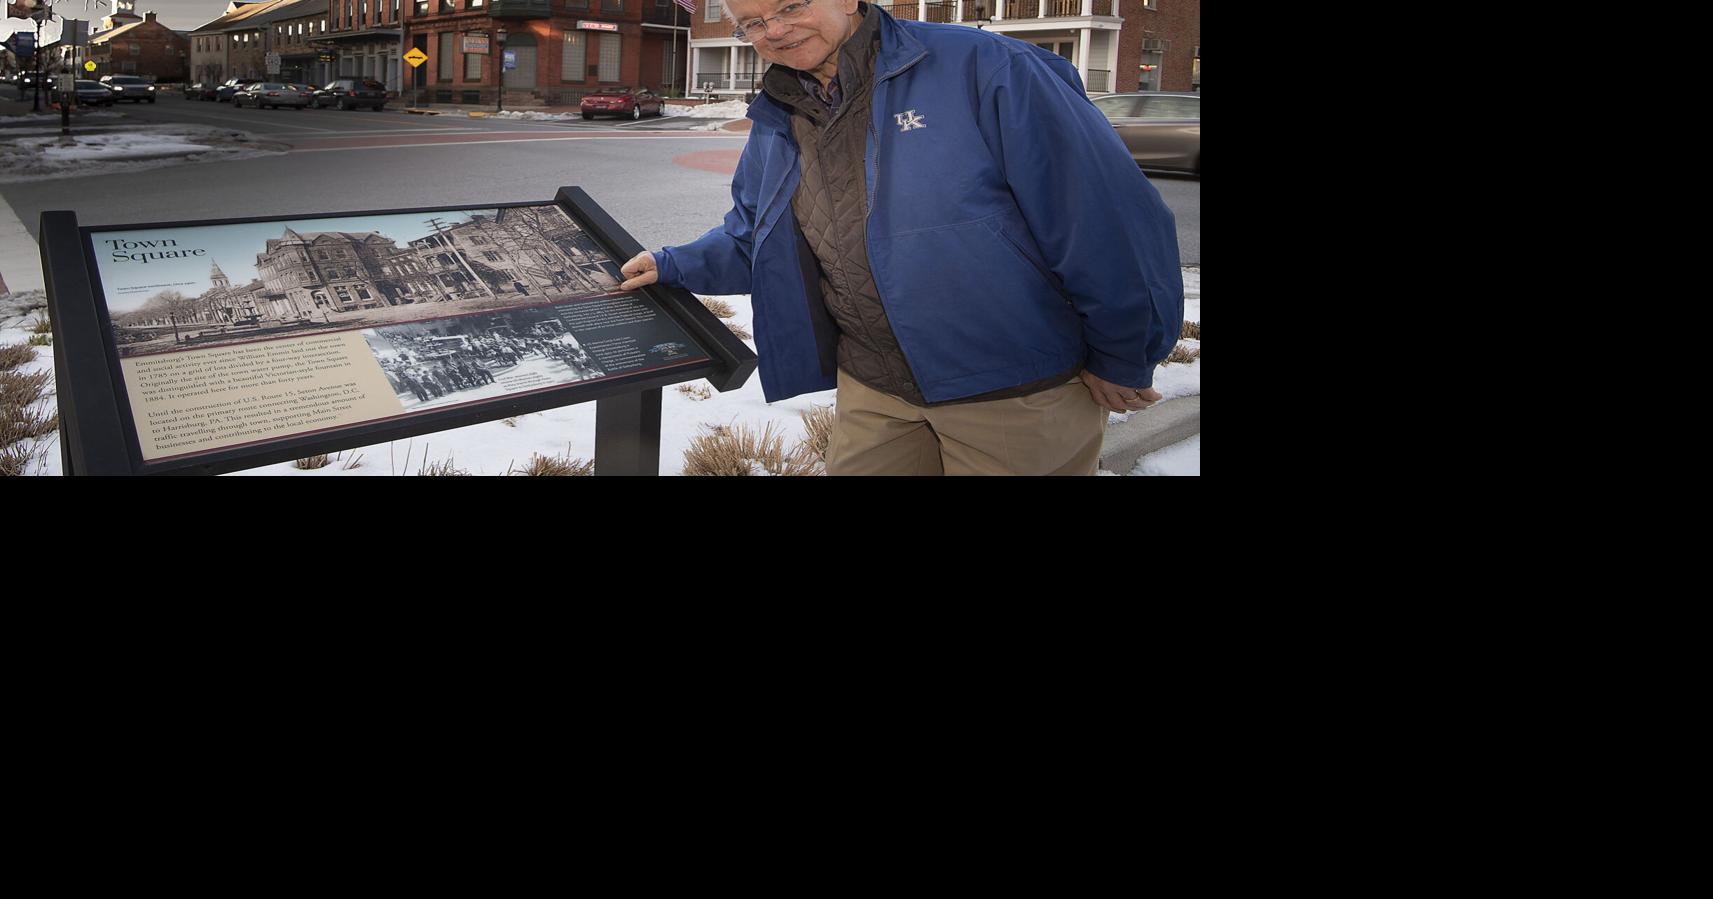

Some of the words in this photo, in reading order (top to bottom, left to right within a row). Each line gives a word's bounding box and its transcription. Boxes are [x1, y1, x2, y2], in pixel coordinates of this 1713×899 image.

[894, 109, 927, 132] UK
[105, 239, 177, 250] Town
[112, 248, 206, 264] Square
[152, 364, 173, 372] social
[175, 361, 201, 369] activity
[188, 367, 202, 375] grid
[227, 360, 253, 368] divided
[140, 379, 178, 388] Originally
[158, 381, 206, 393] distinguished
[232, 373, 263, 382] beautiful
[314, 362, 342, 370] fountain
[176, 388, 208, 398] operated
[147, 409, 168, 418] Until
[185, 401, 231, 412] construction
[149, 416, 177, 426] located
[206, 408, 236, 418] primary
[258, 398, 298, 408] connecting
[224, 414, 241, 422] This
[243, 409, 271, 418] resulted
[288, 400, 329, 411] tremendous
[330, 395, 357, 404] amount
[153, 433, 178, 442] traffic
[179, 427, 216, 437] travelling
[217, 420, 247, 431] through
[272, 411, 311, 421] supporting
[331, 403, 351, 411] Street
[155, 439, 196, 450] businesses
[197, 435, 212, 443] and
[214, 427, 262, 440] contributing
[286, 419, 303, 427] local
